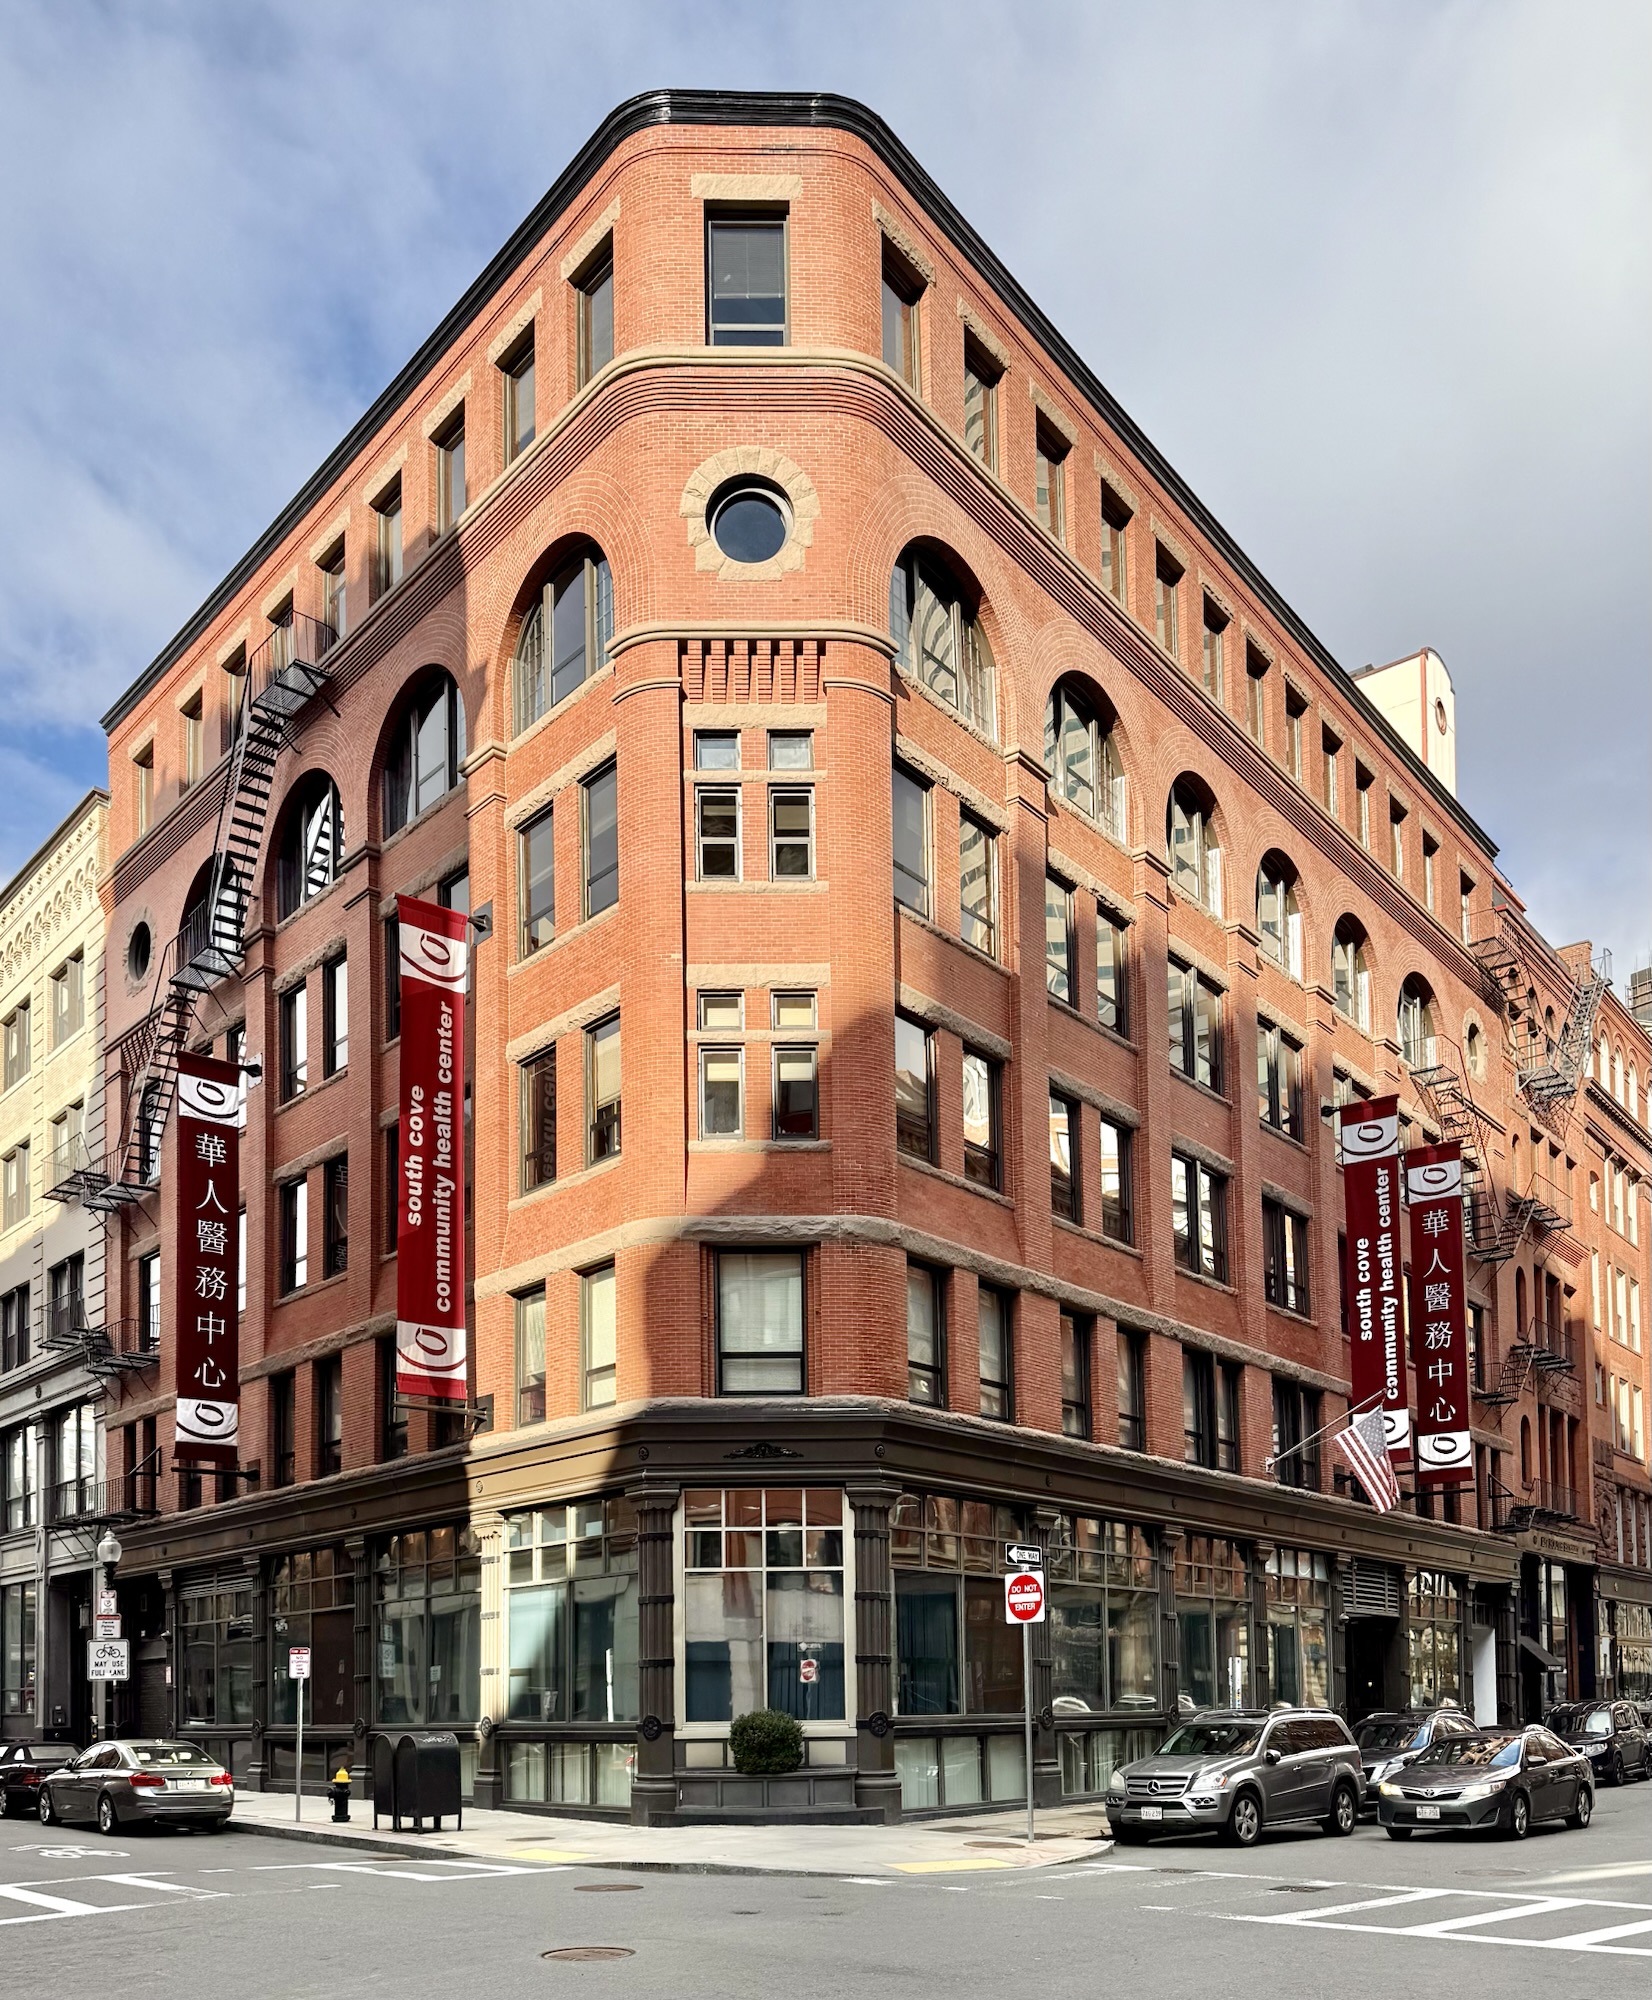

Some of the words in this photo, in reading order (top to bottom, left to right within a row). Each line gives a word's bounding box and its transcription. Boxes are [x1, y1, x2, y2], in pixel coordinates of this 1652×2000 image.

[437, 1000, 453, 1084] center
[408, 1085, 425, 1147] cove
[432, 1090, 452, 1169] health
[404, 1154, 424, 1227] south
[1375, 1167, 1391, 1228] center
[194, 1132, 229, 1388] 華人醫務中心
[432, 1174, 456, 1313] community
[1357, 1238, 1371, 1283] cove
[1377, 1232, 1394, 1292] health
[1356, 1287, 1373, 1341] south
[1421, 1208, 1456, 1422] 華人醫務中心
[1381, 1296, 1398, 1400] community
[1016, 1550, 1027, 1560] ONE
[1027, 1551, 1039, 1561] WAY
[1015, 1603, 1035, 1611] ENTER
[1024, 1584, 1037, 1593] NOT
